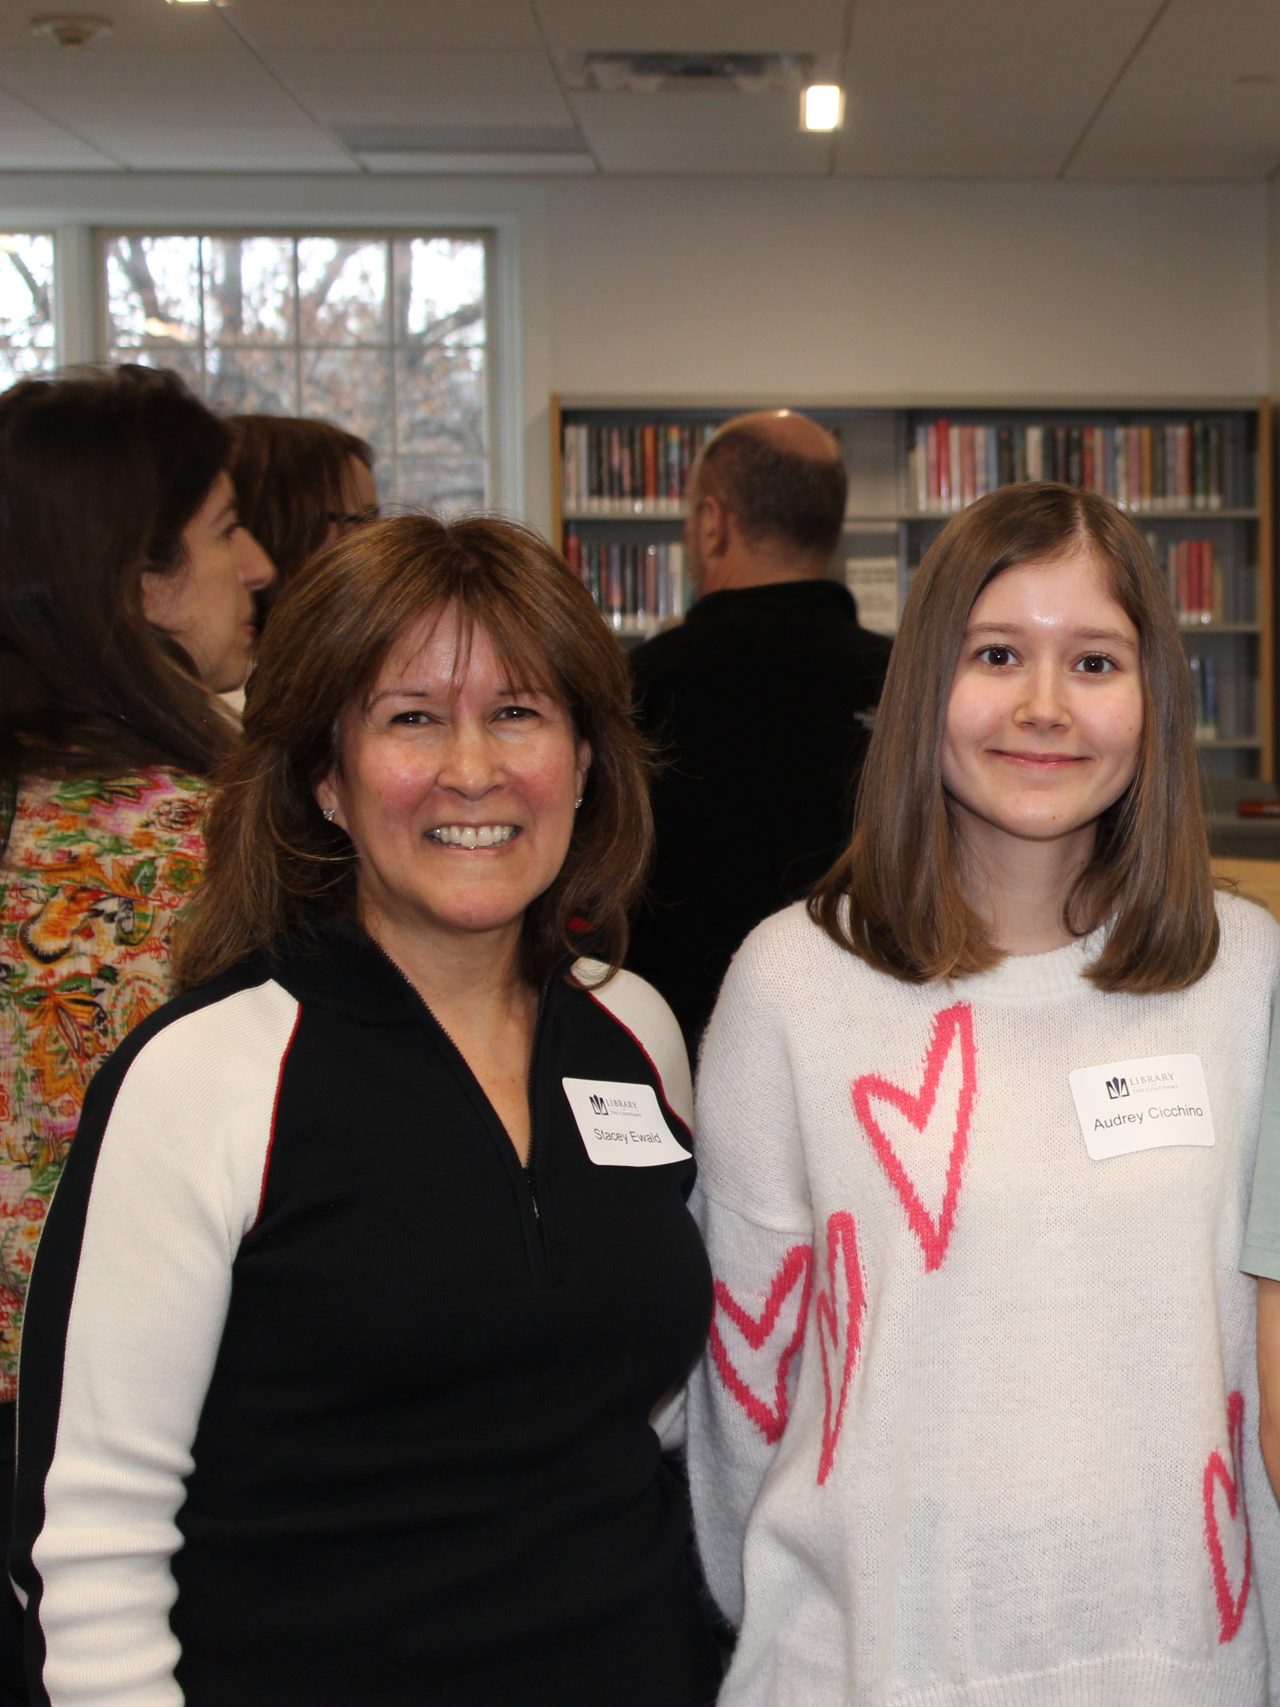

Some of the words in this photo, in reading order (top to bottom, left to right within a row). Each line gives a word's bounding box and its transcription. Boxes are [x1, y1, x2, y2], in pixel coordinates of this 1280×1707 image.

[1130, 1073, 1174, 1086] LIBRARY
[605, 1099, 637, 1109] LIBRARY
[1094, 1112, 1144, 1131] Audrey
[1148, 1105, 1203, 1119] Cicchino
[593, 1128, 628, 1144] Stacey
[629, 1131, 662, 1143] Ewald
